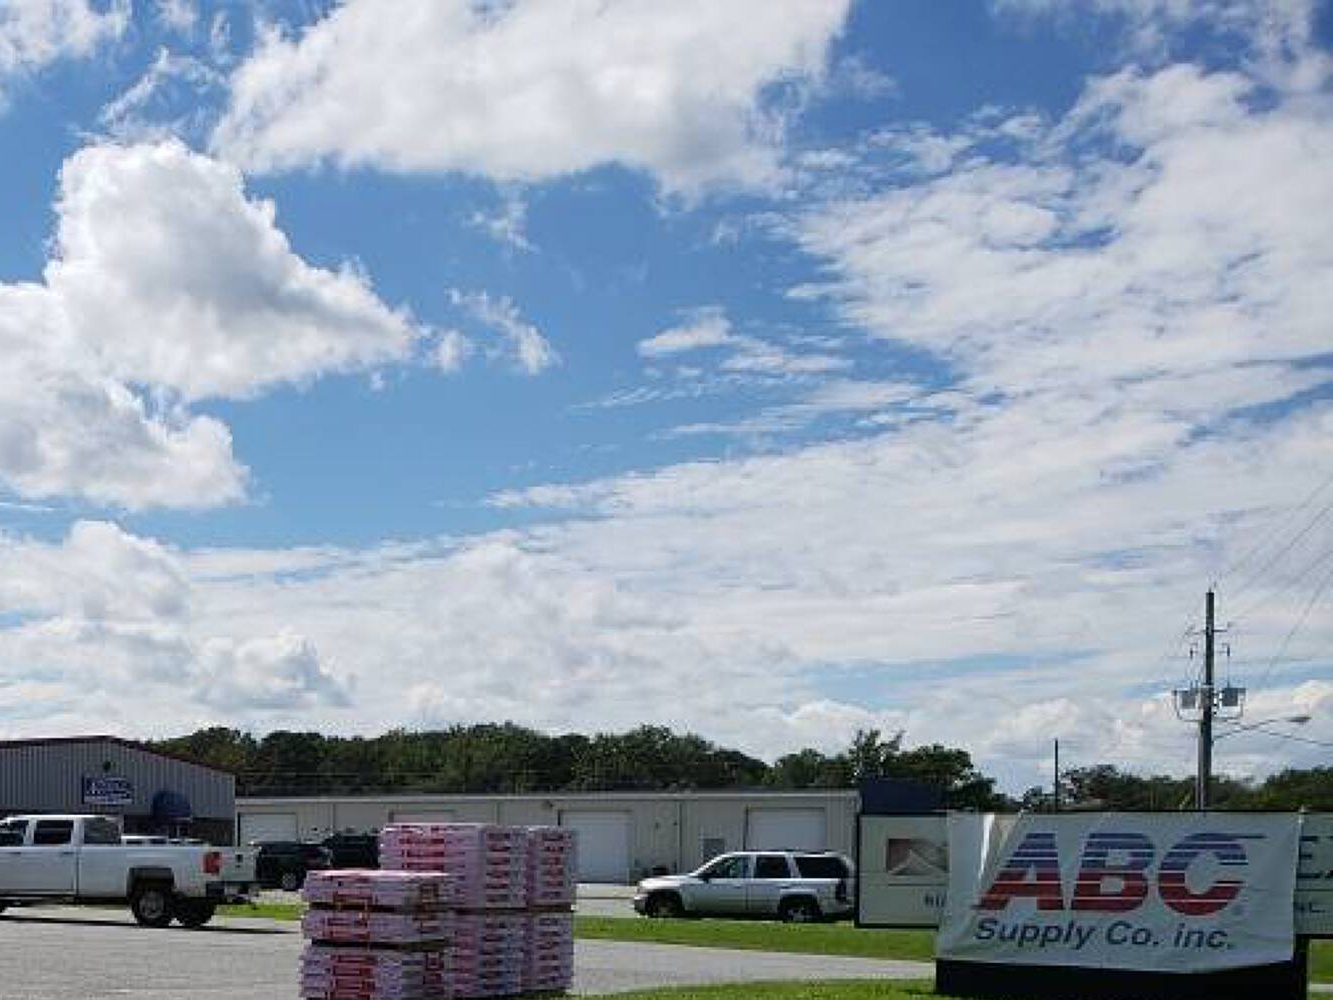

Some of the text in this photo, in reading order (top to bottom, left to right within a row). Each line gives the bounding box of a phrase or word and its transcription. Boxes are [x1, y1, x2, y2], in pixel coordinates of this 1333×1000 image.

[972, 832, 1267, 916] ABC
[975, 918, 1234, 950] Supply Co. inc.
